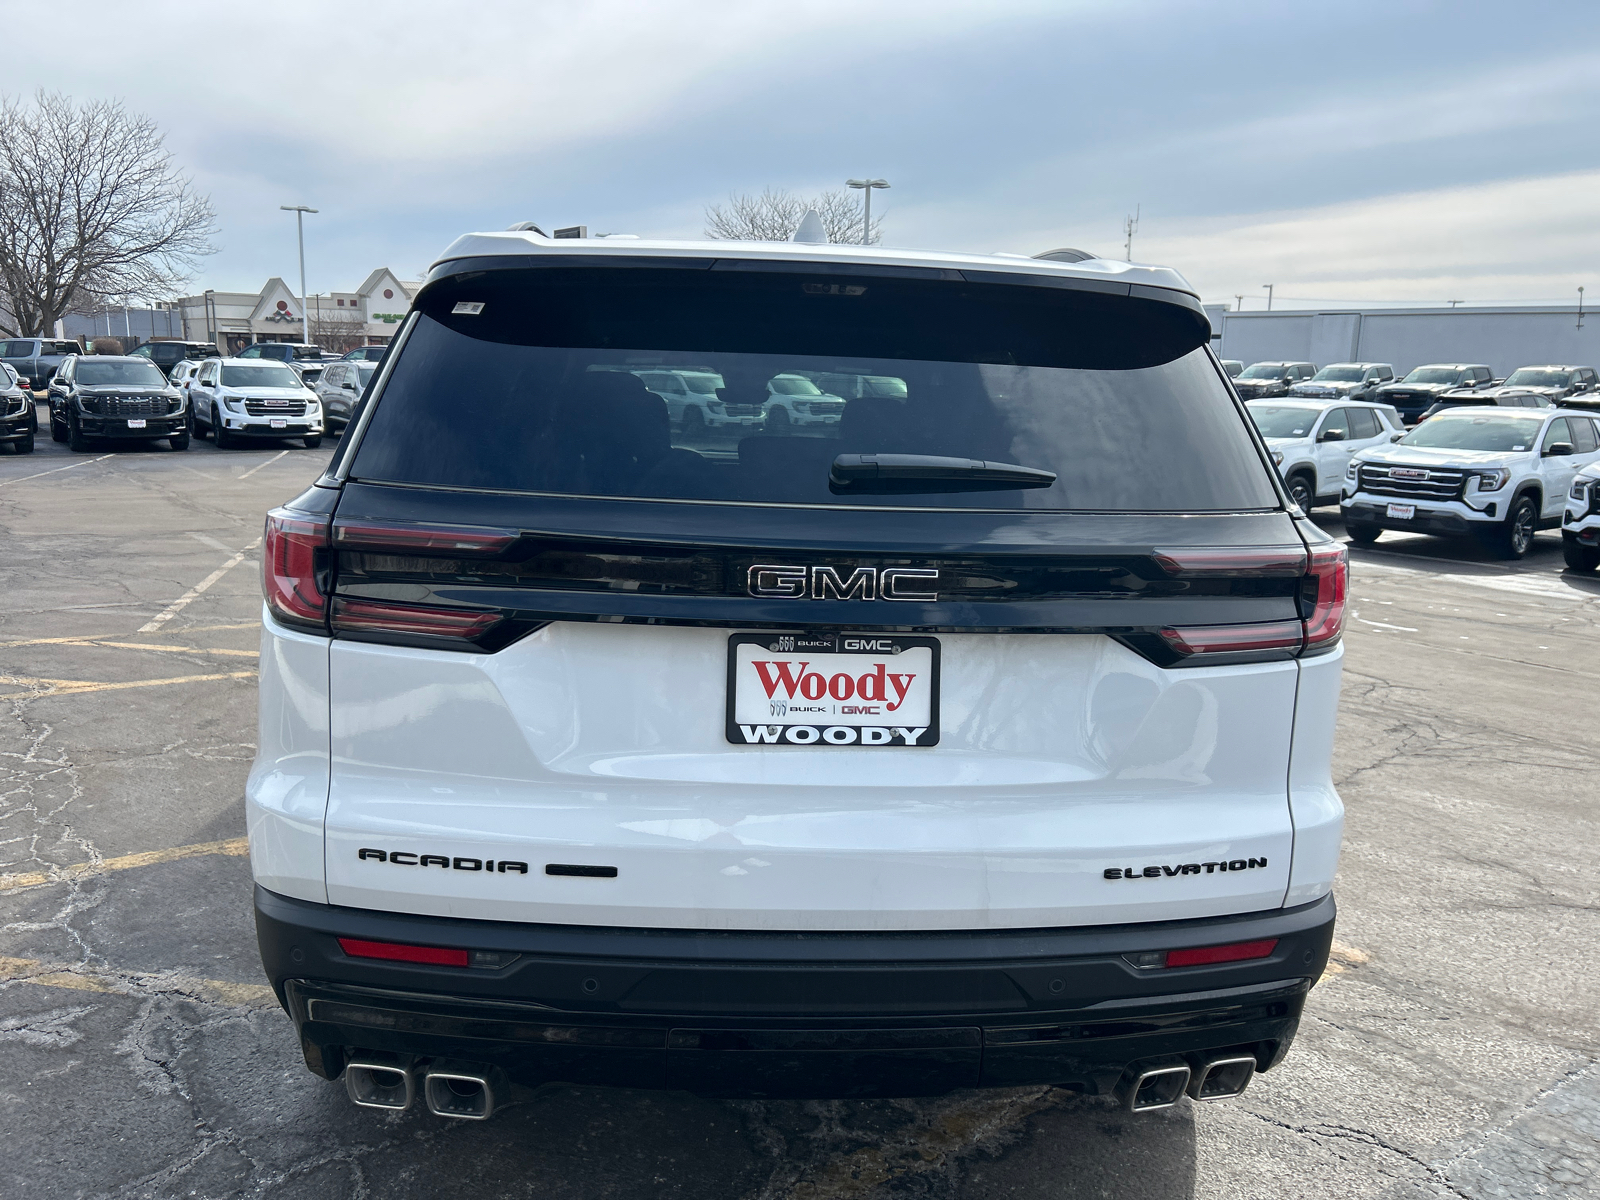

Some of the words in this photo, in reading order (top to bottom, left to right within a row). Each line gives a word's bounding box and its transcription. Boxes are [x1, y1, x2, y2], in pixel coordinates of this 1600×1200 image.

[747, 564, 939, 602] GMC
[844, 639, 892, 651] GMC
[751, 660, 916, 712] Woody
[841, 705, 880, 715] GMC
[739, 725, 927, 746] WOODY
[358, 847, 528, 874] ACADIA
[1103, 856, 1268, 880] ELEVATION
